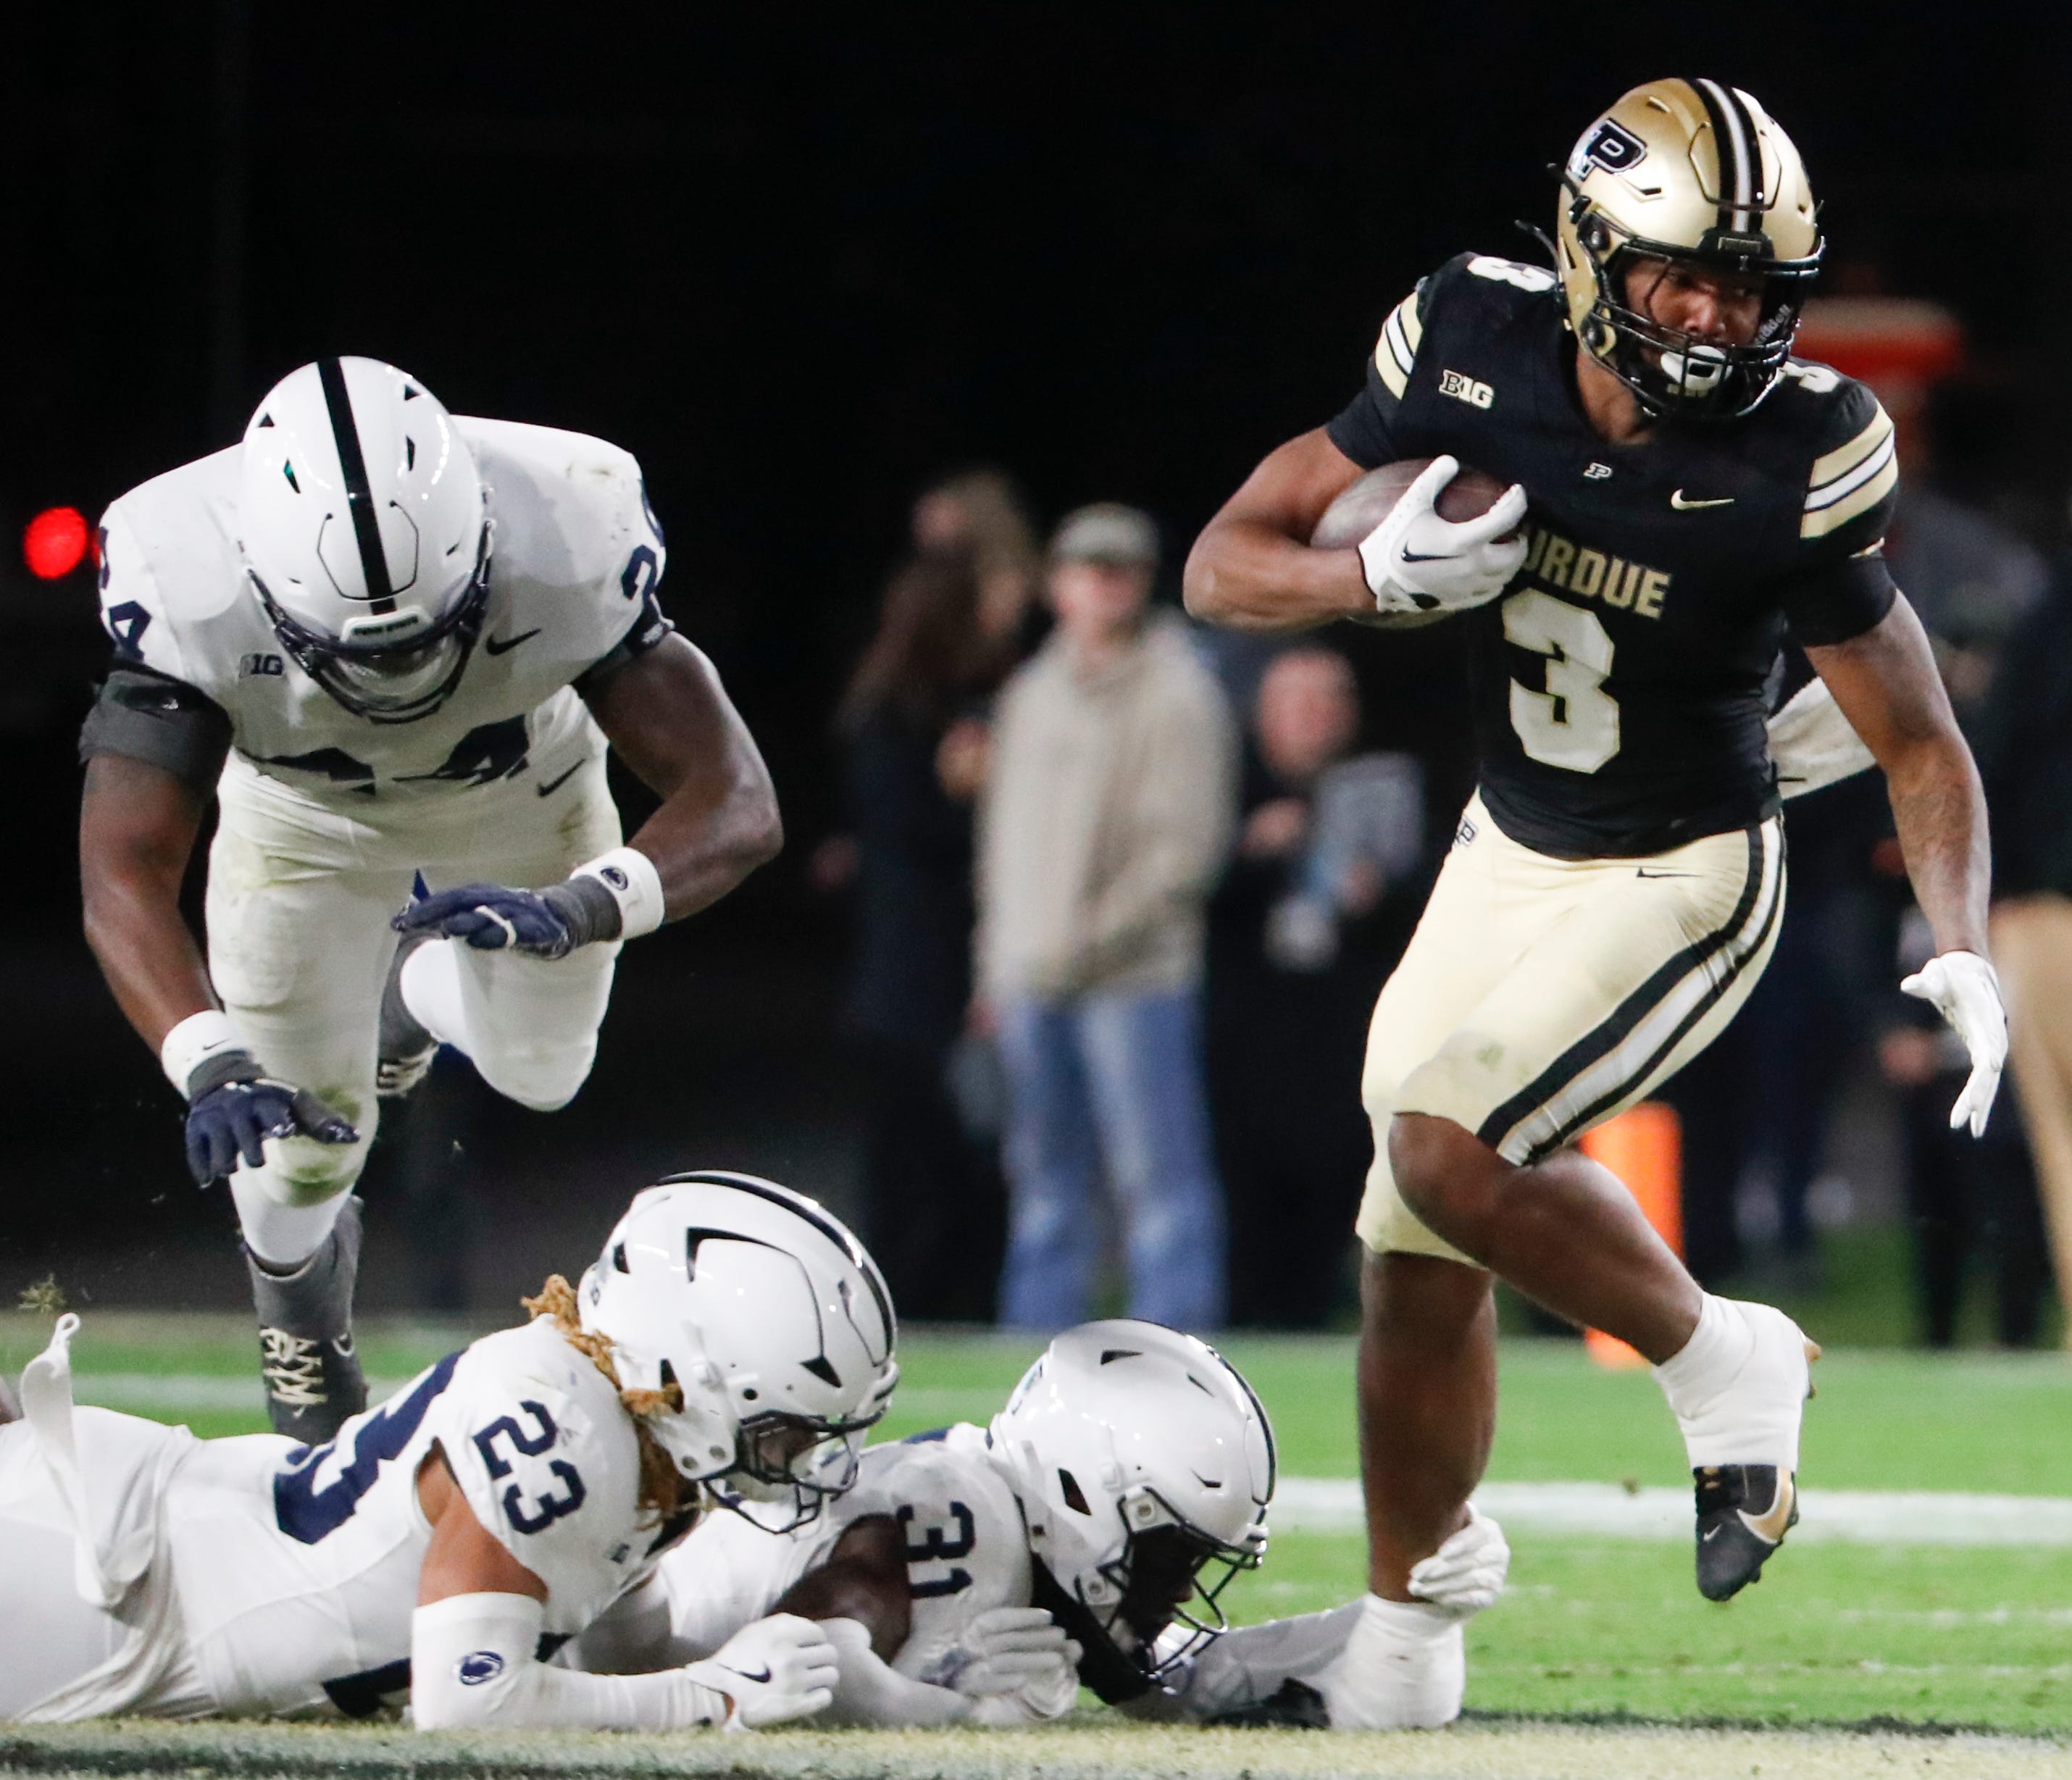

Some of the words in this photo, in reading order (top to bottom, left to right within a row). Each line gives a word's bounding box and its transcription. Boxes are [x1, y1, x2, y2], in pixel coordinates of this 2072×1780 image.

[1566, 117, 1647, 182] P
[1582, 462, 1612, 479] P
[1521, 523, 1672, 621] URDUE
[1502, 587, 1621, 774] 3
[472, 1400, 586, 1534] 23
[896, 1501, 976, 1599] 31
